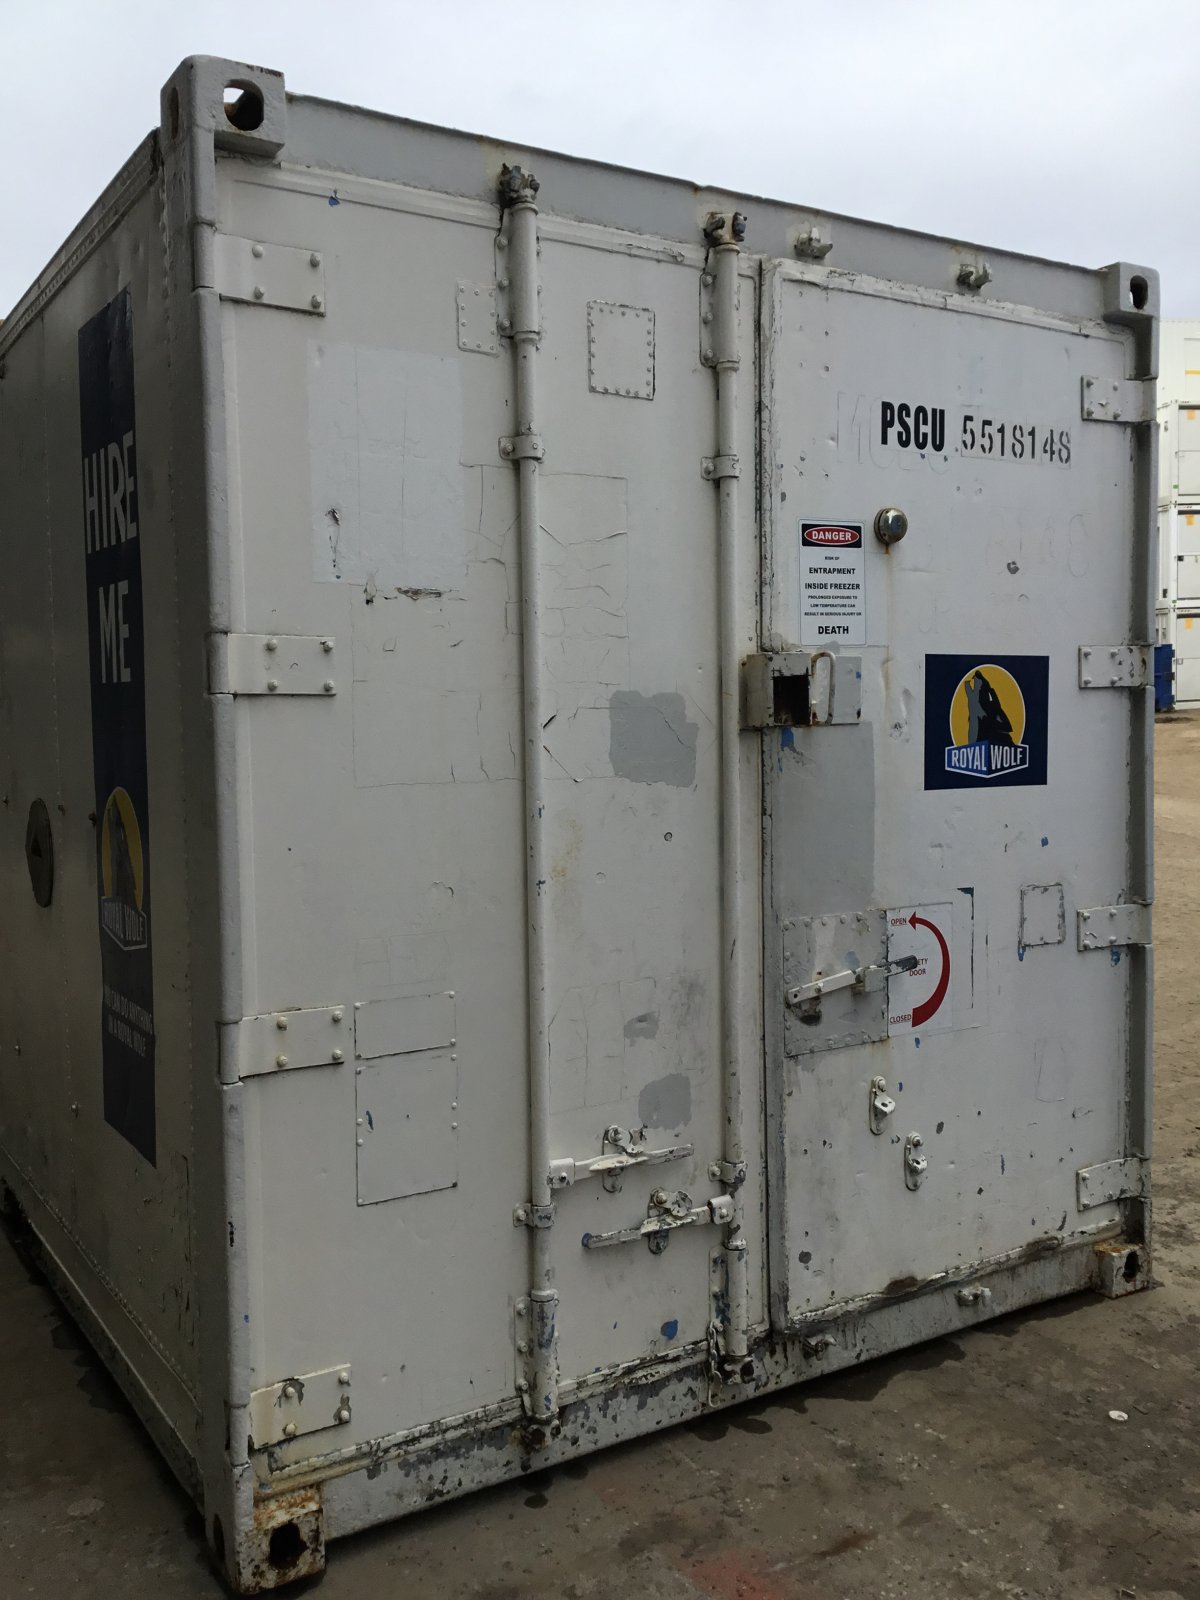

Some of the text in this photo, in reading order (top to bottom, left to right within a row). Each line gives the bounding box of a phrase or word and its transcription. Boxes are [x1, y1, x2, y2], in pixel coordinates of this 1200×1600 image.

[881, 401, 945, 452] PSCU
[84, 430, 137, 554] HIRE
[812, 531, 852, 540] DANGER
[99, 579, 131, 684] ME
[818, 626, 849, 634] DEATH
[952, 744, 1022, 770] ROYAL WOLF
[124, 904, 144, 941] WOLF
[909, 968, 926, 976] DOOR
[890, 1014, 912, 1024] CLOSED
